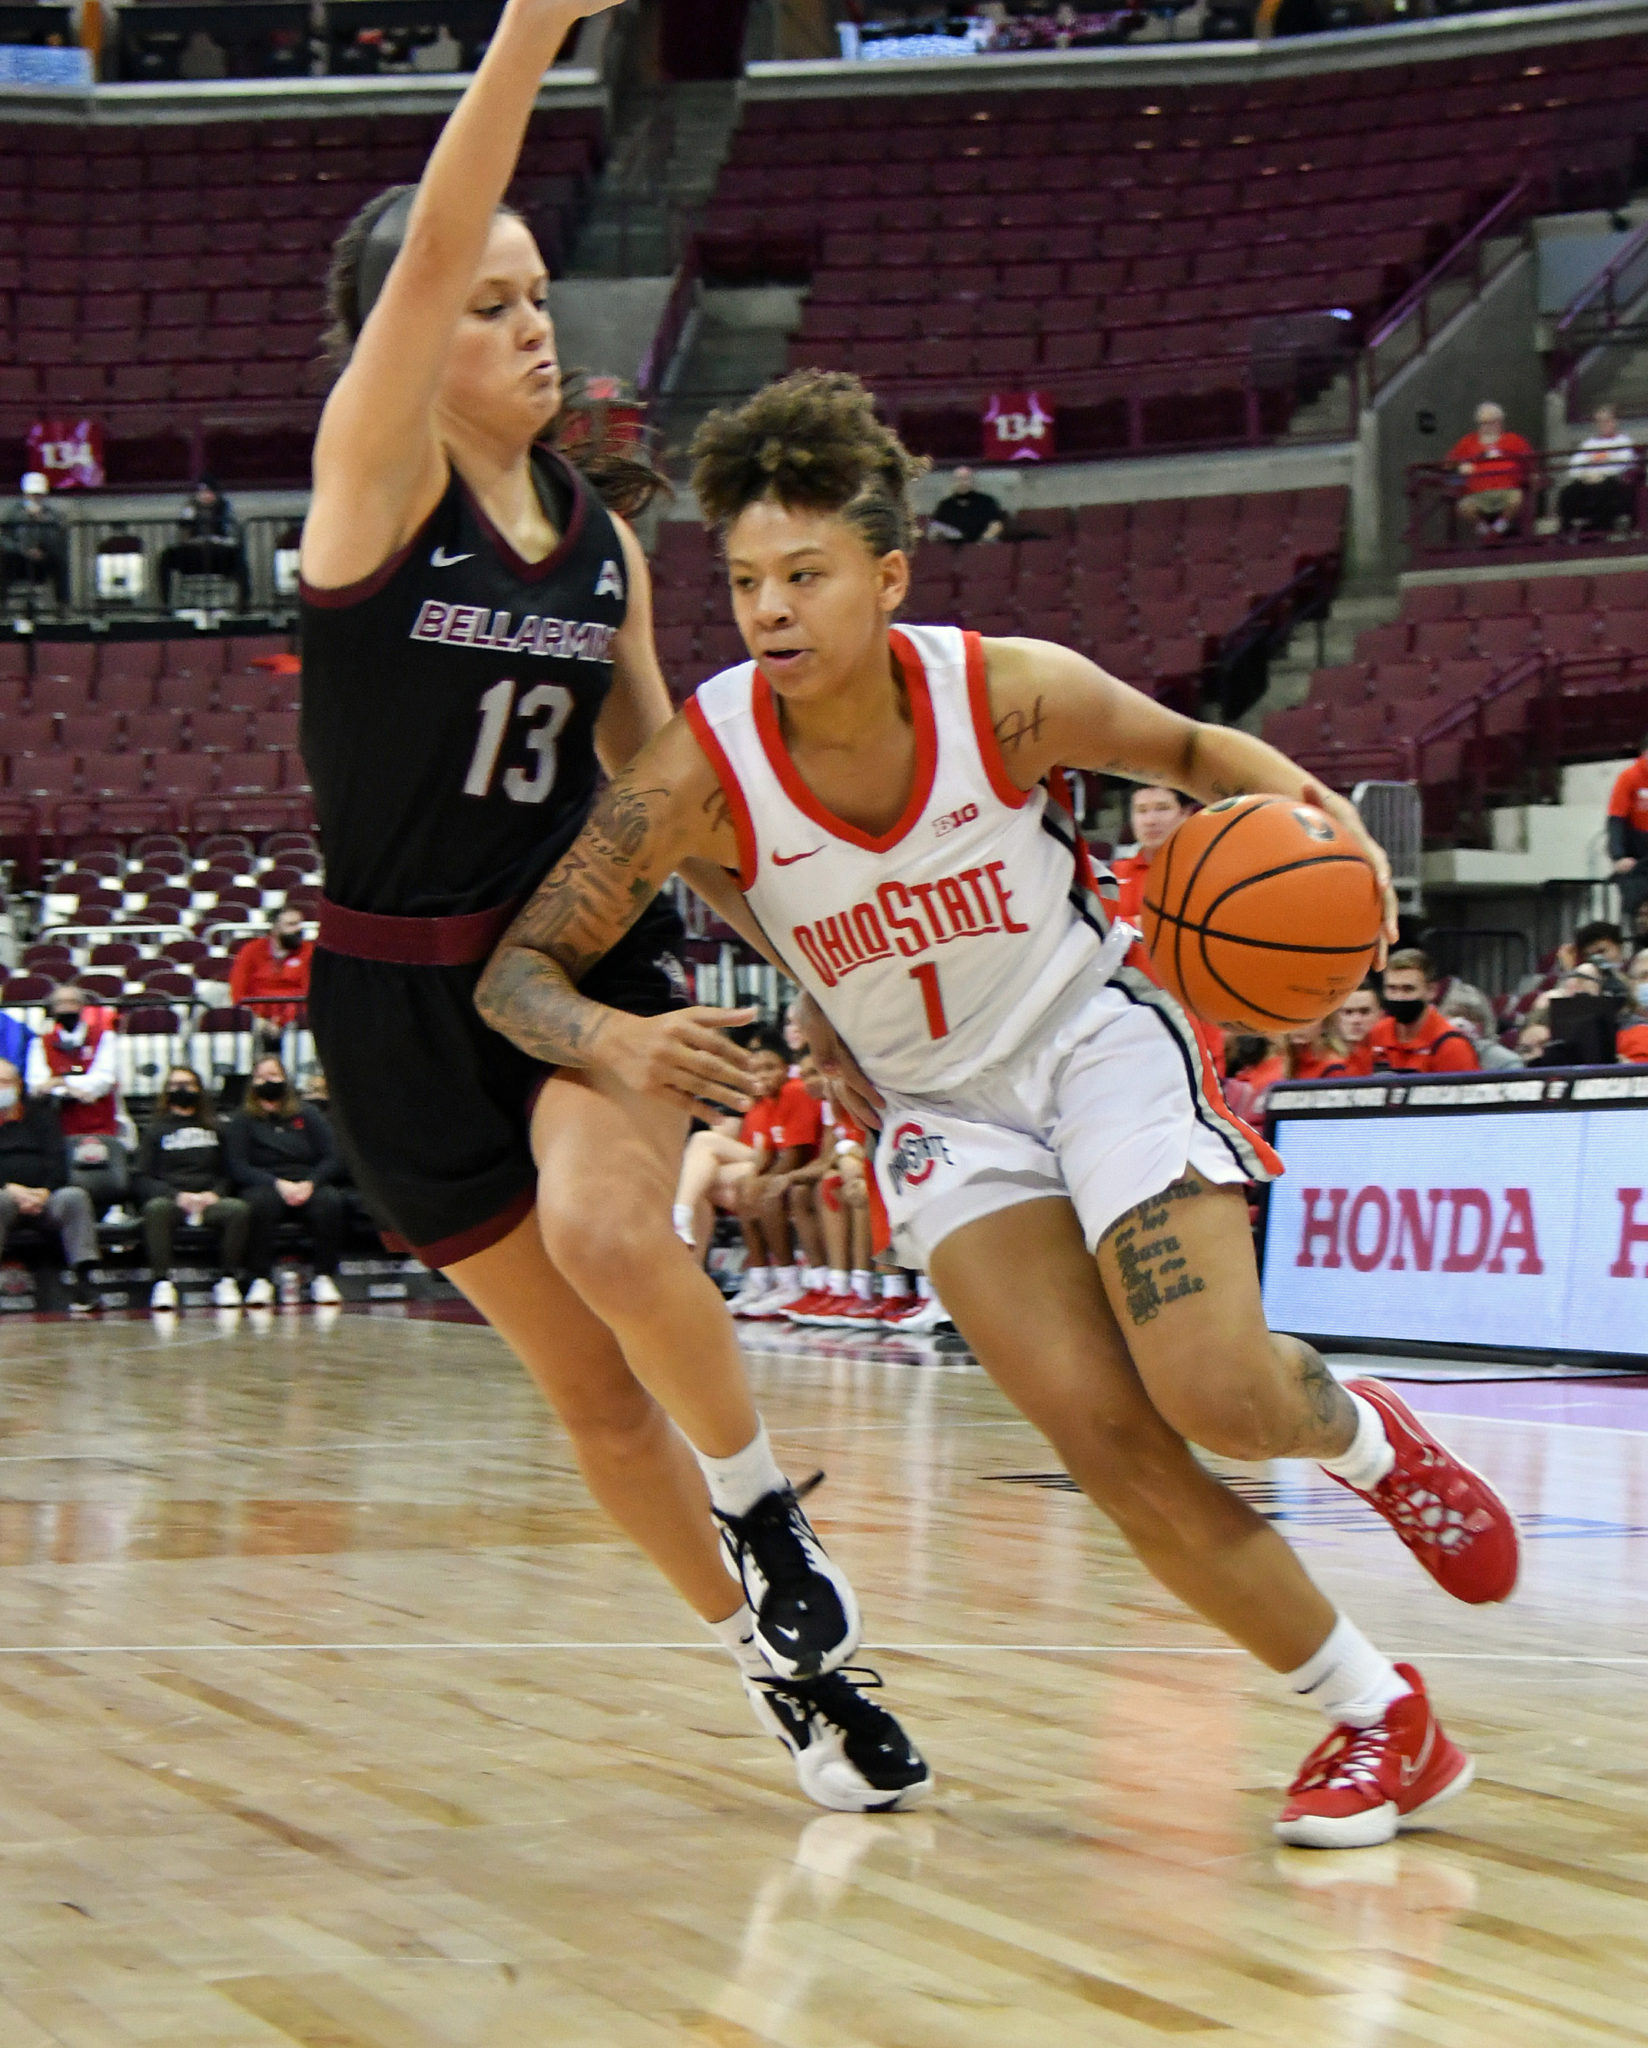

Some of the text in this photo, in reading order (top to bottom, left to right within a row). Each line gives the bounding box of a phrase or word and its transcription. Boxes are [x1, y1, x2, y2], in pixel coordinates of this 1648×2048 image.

[995, 412, 1046, 441] 134
[463, 679, 576, 804] 13
[908, 960, 949, 1041] 1
[1296, 1185, 1544, 1276] HONDA
